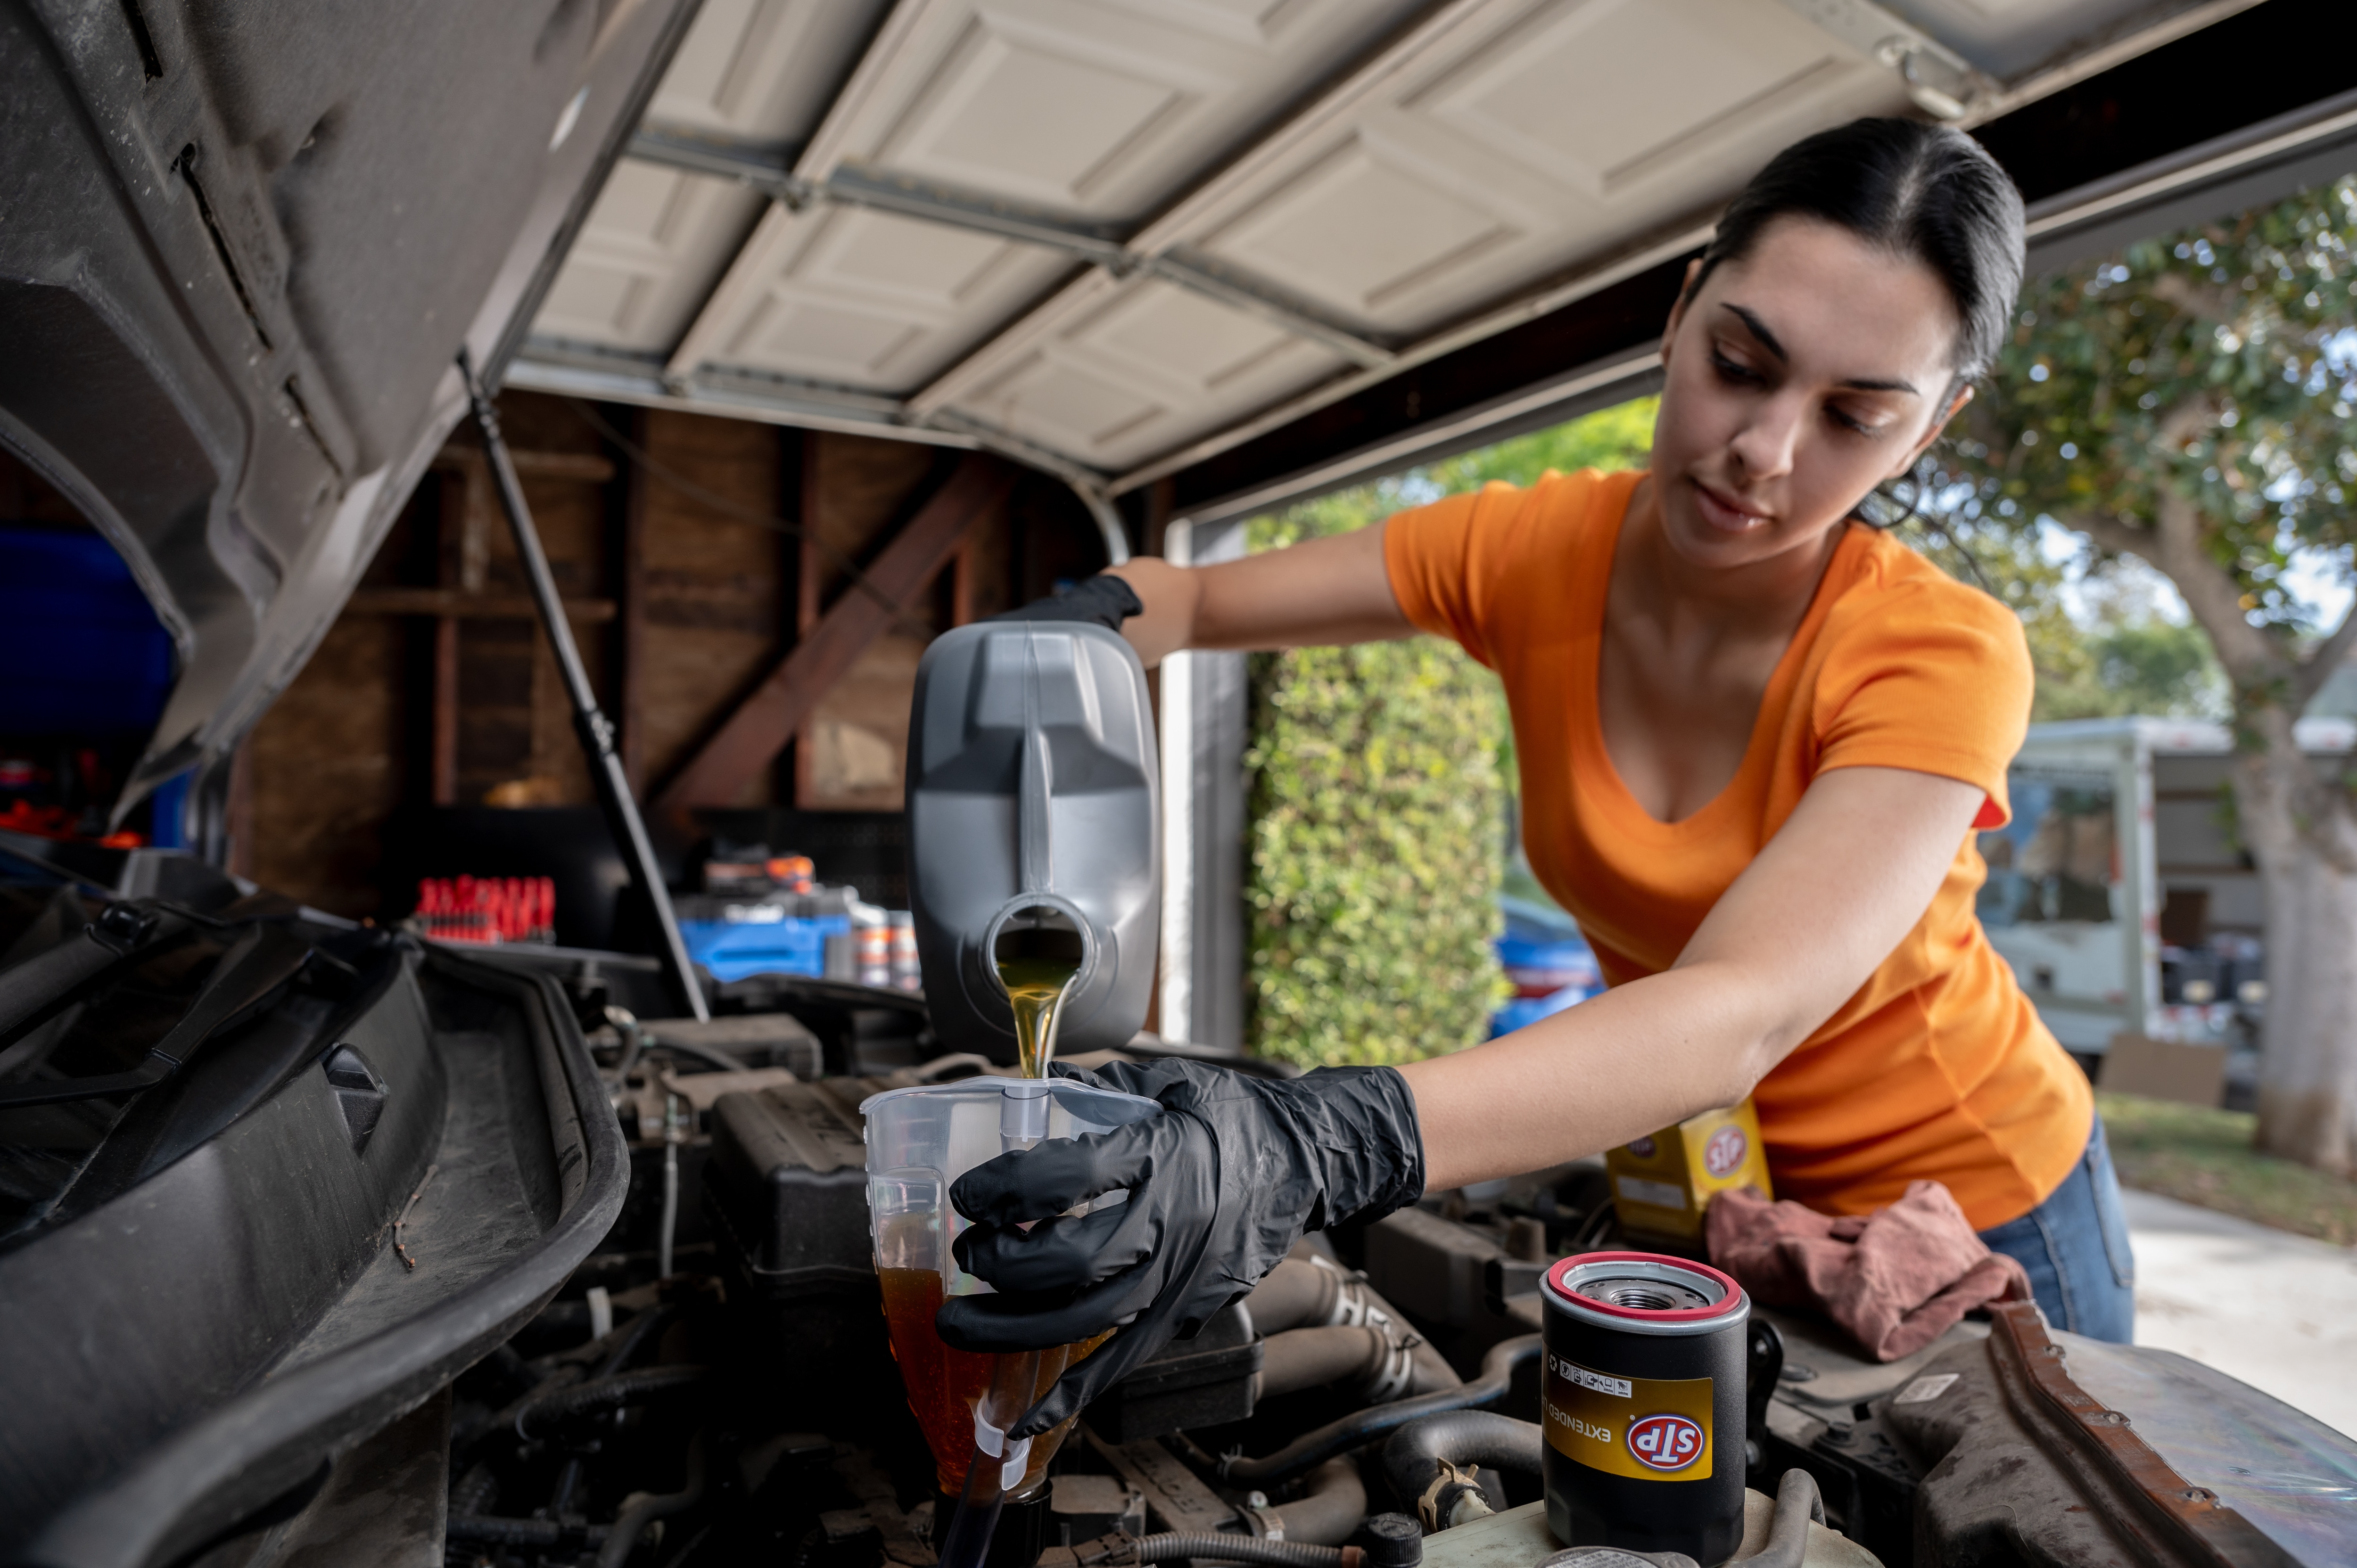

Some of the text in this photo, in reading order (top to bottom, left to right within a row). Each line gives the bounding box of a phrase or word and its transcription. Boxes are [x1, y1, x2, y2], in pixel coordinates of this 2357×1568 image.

[1709, 1132, 1741, 1172] STP
[1549, 1404, 1611, 1443] EXTENDED
[1637, 1424, 1696, 1463] STP
